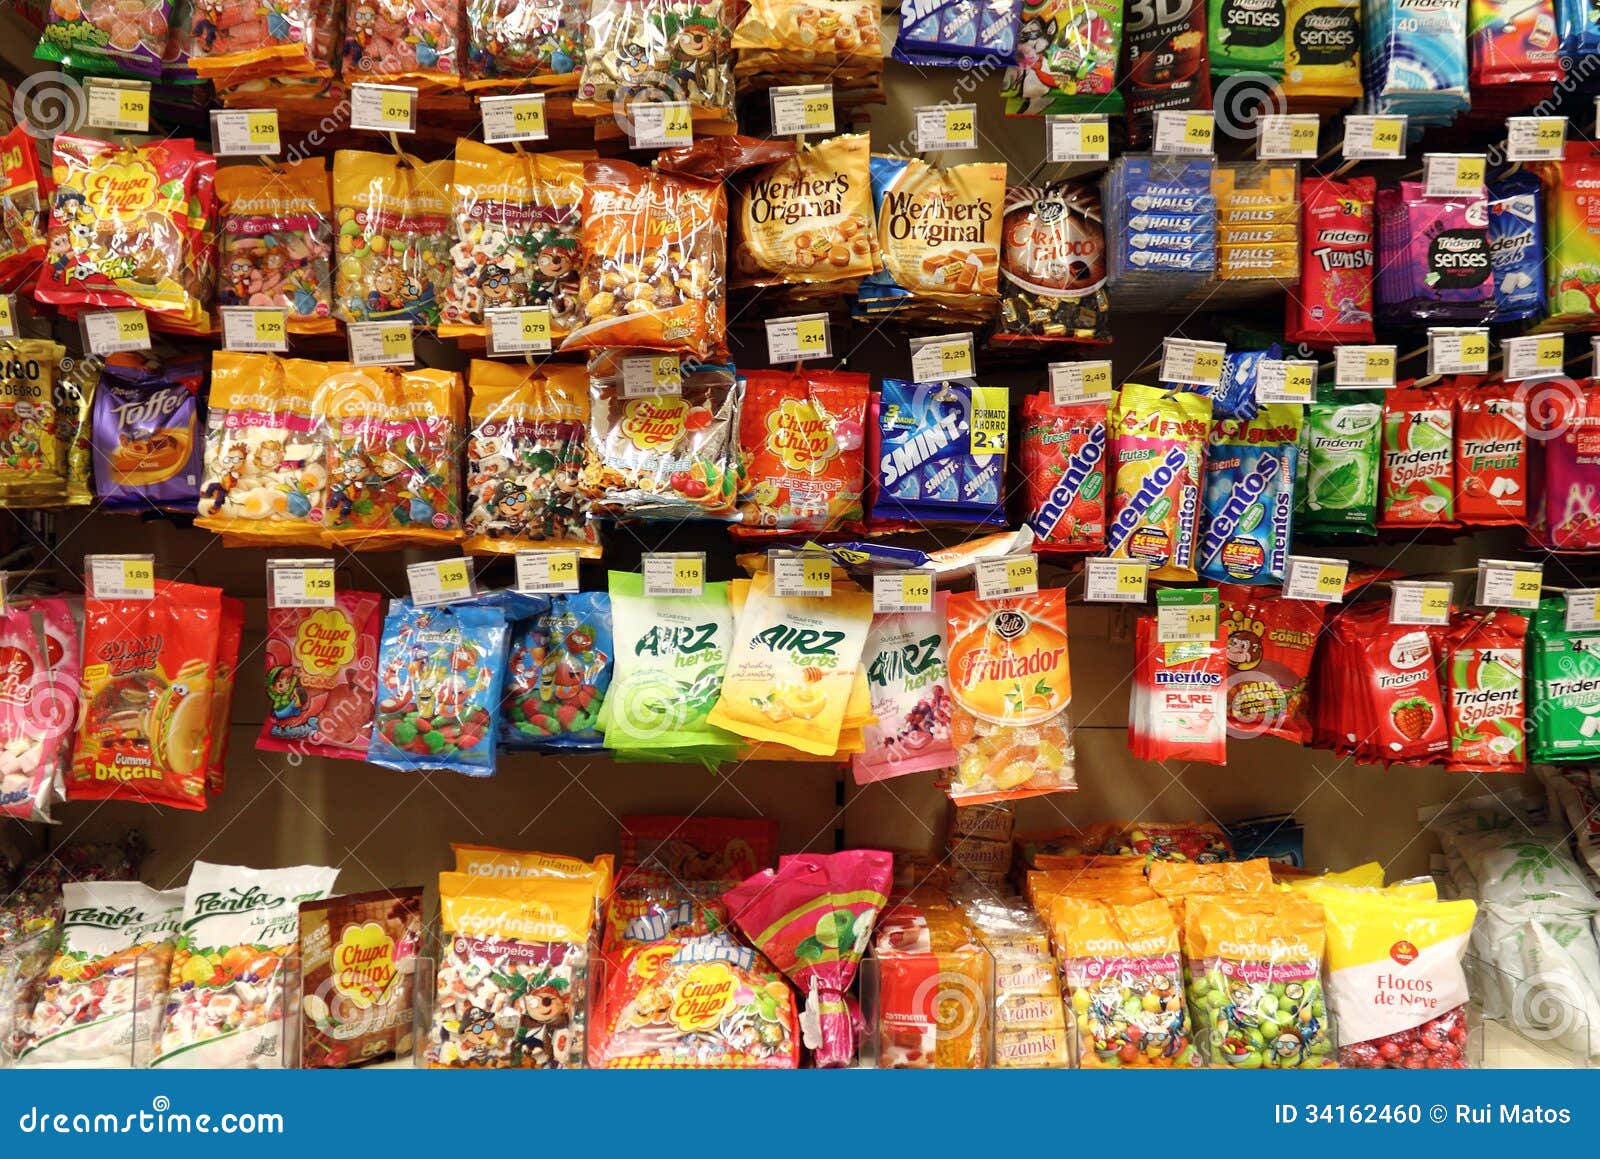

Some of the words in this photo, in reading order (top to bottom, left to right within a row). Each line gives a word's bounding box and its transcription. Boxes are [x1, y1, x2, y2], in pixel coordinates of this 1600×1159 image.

[1227, 9, 1280, 27] senses
[1398, 18, 1418, 32] 40
[1300, 30, 1354, 45] senses
[95, 175, 149, 190] Chupa
[751, 171, 849, 201] Werther's
[89, 190, 145, 206] Chups
[1151, 197, 1193, 208] HALLS
[750, 196, 842, 226] Original
[1230, 210, 1274, 220] HALLS
[889, 214, 985, 246] Original
[1149, 217, 1191, 228] HALLS
[1149, 235, 1191, 247] HALLS
[1228, 231, 1273, 242] HALLS
[1318, 229, 1371, 242] Trident
[1438, 237, 1482, 251] Trident
[1151, 252, 1191, 264] HALLS
[1229, 249, 1274, 260] HALLS
[1434, 253, 1488, 267] senses
[635, 403, 683, 421] Chupa
[974, 409, 1006, 420] FORMATO
[629, 420, 681, 436] Chups
[974, 420, 1006, 430] AHORRO
[1248, 424, 1298, 443] gratis
[774, 431, 830, 452] Chups
[1041, 432, 1071, 445] fresa
[1315, 437, 1363, 449] Trident
[881, 412, 960, 487] SMINT
[1119, 450, 1150, 462] frutas
[1387, 448, 1449, 467] Trident
[1464, 440, 1522, 457] Trident
[1472, 455, 1519, 472] Fruit
[925, 460, 957, 494] SMINT
[963, 465, 996, 497] SMINT
[1394, 461, 1444, 485] Splash
[824, 482, 842, 492] OF
[1033, 424, 1106, 541] mentos
[1175, 485, 1198, 568] mentos
[1270, 493, 1290, 574] mentos
[305, 623, 350, 643] Chupa
[755, 624, 845, 655] AIRZ
[300, 640, 346, 660] Chups
[675, 648, 723, 668] herbs
[790, 649, 839, 669] herbs
[963, 647, 1065, 688] Fruitador
[1156, 671, 1222, 685] mentos
[1379, 671, 1428, 689] Trident
[1455, 688, 1520, 706] Trident
[1462, 702, 1514, 724] Splash
[196, 886, 285, 914] Penha
[342, 943, 388, 966] Chupa
[471, 942, 535, 958] Caramelos
[340, 964, 391, 988] Chups
[1378, 974, 1433, 992] Flocos
[682, 981, 732, 1000] Chupa
[676, 998, 727, 1018] Chups
[1374, 992, 1394, 1006] de
[1400, 992, 1437, 1009] Neve
